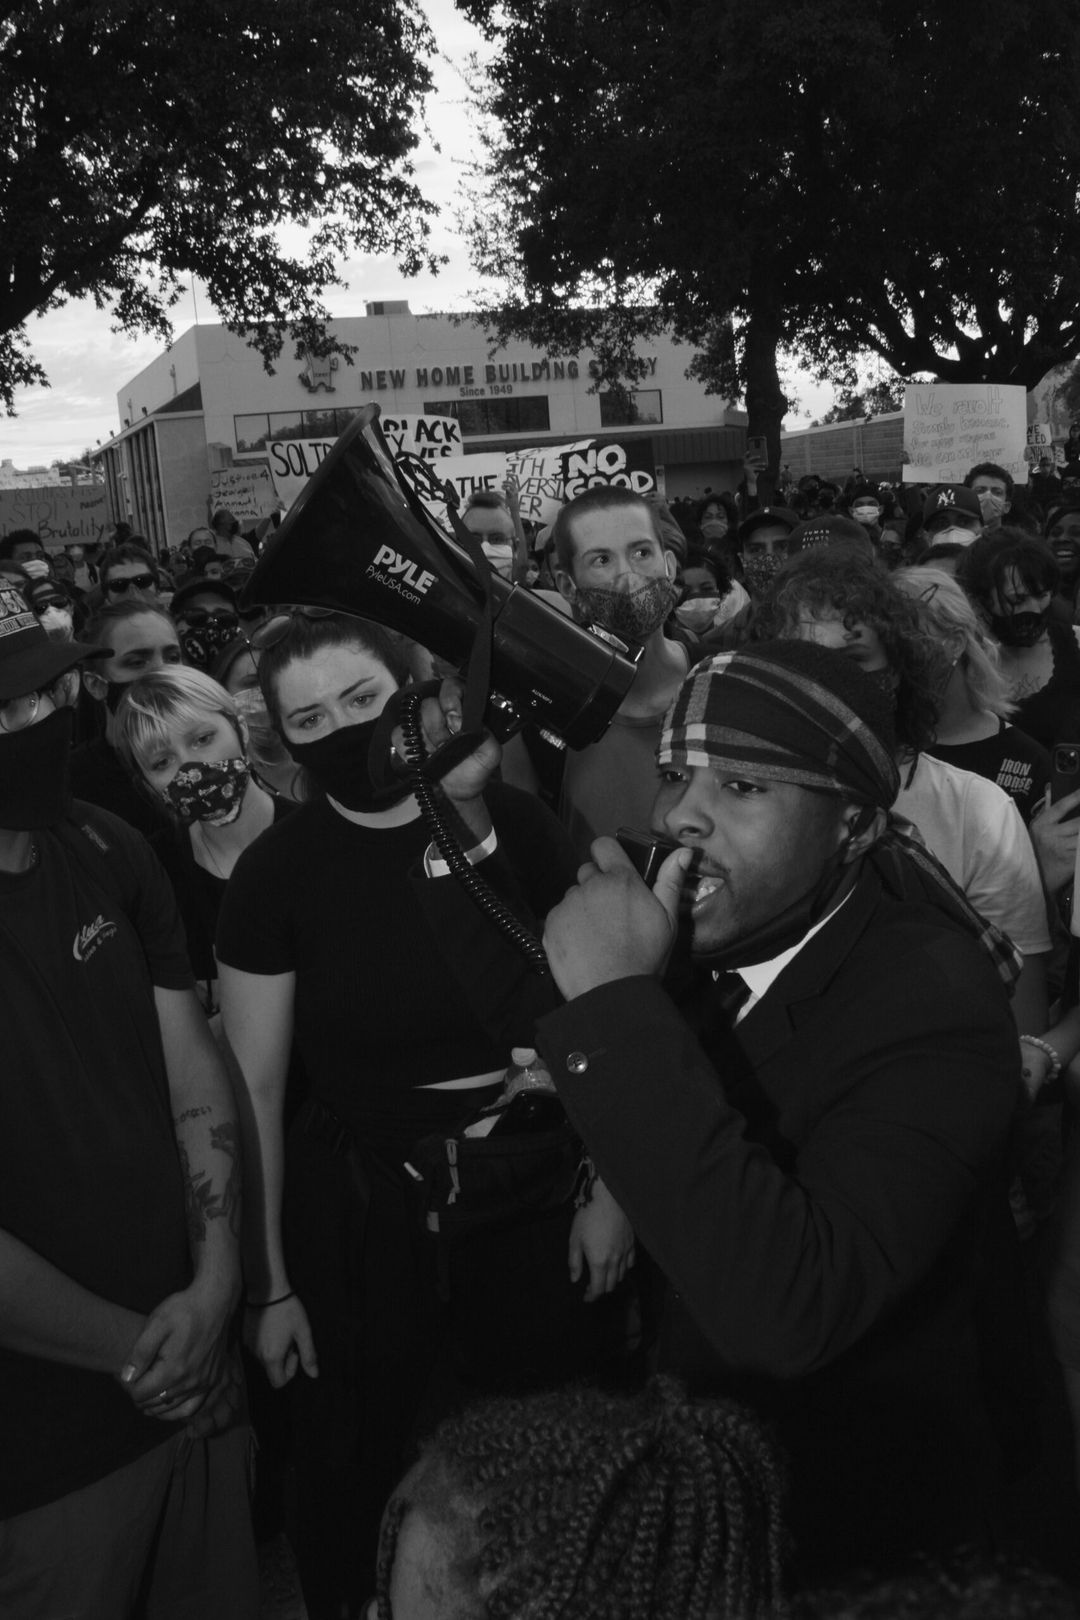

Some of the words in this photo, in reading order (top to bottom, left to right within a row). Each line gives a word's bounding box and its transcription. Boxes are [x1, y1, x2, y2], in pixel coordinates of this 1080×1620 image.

[360, 369, 406, 392] NEW
[416, 365, 475, 388] HOME
[485, 360, 580, 385] BUILDING
[459, 385, 485, 398] Since
[489, 384, 513, 396] 1949
[568, 444, 626, 478] NO
[565, 470, 654, 501] GOOD
[38, 517, 105, 543] Brutality
[365, 564, 422, 605] PyleUSA.com
[372, 544, 436, 595] PYLE
[996, 772, 1033, 790] HORSE
[1000, 758, 1032, 776] IRON
